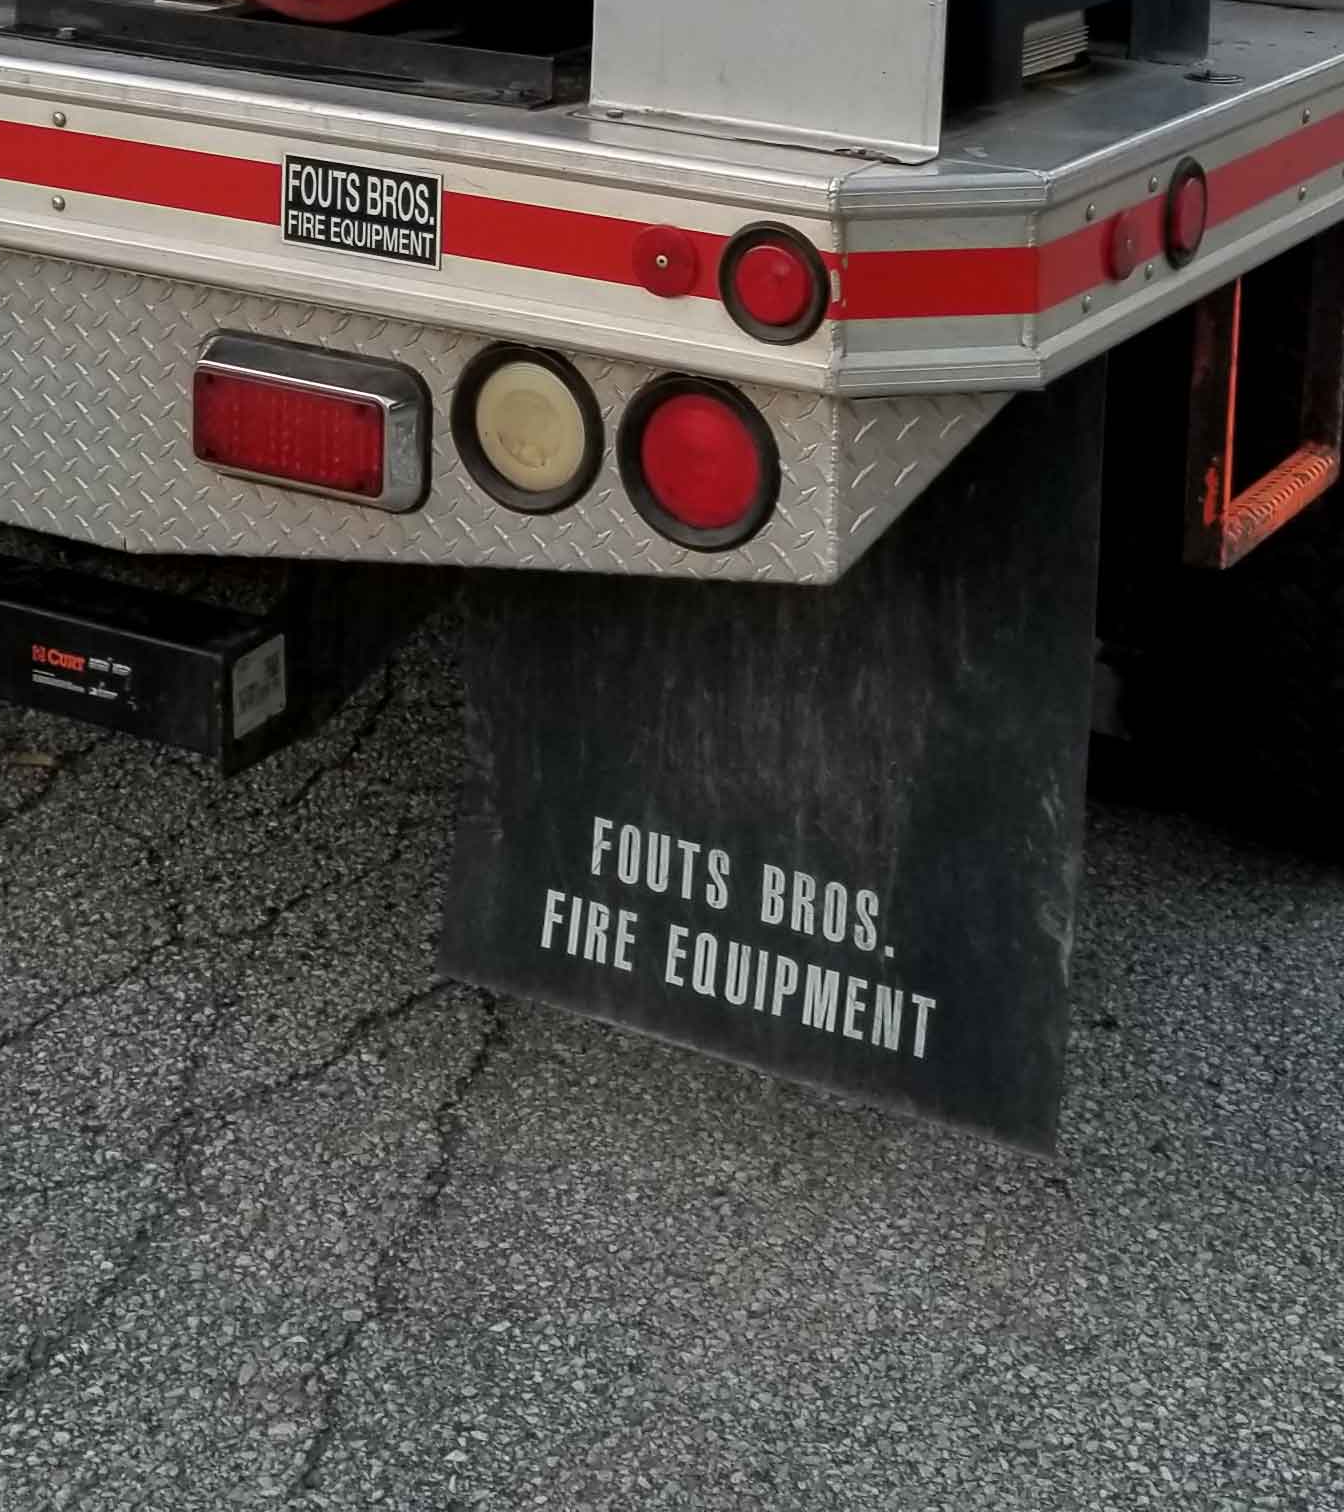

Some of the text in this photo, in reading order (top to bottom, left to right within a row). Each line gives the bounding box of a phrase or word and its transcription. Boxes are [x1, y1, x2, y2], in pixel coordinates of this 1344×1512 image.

[287, 210, 434, 259] FIRE EQUIPMENT
[288, 163, 435, 226] FOUTS BROS.
[591, 815, 895, 959] FOUTS BROS.
[539, 888, 937, 1060] FIRE EQUIPMENT
